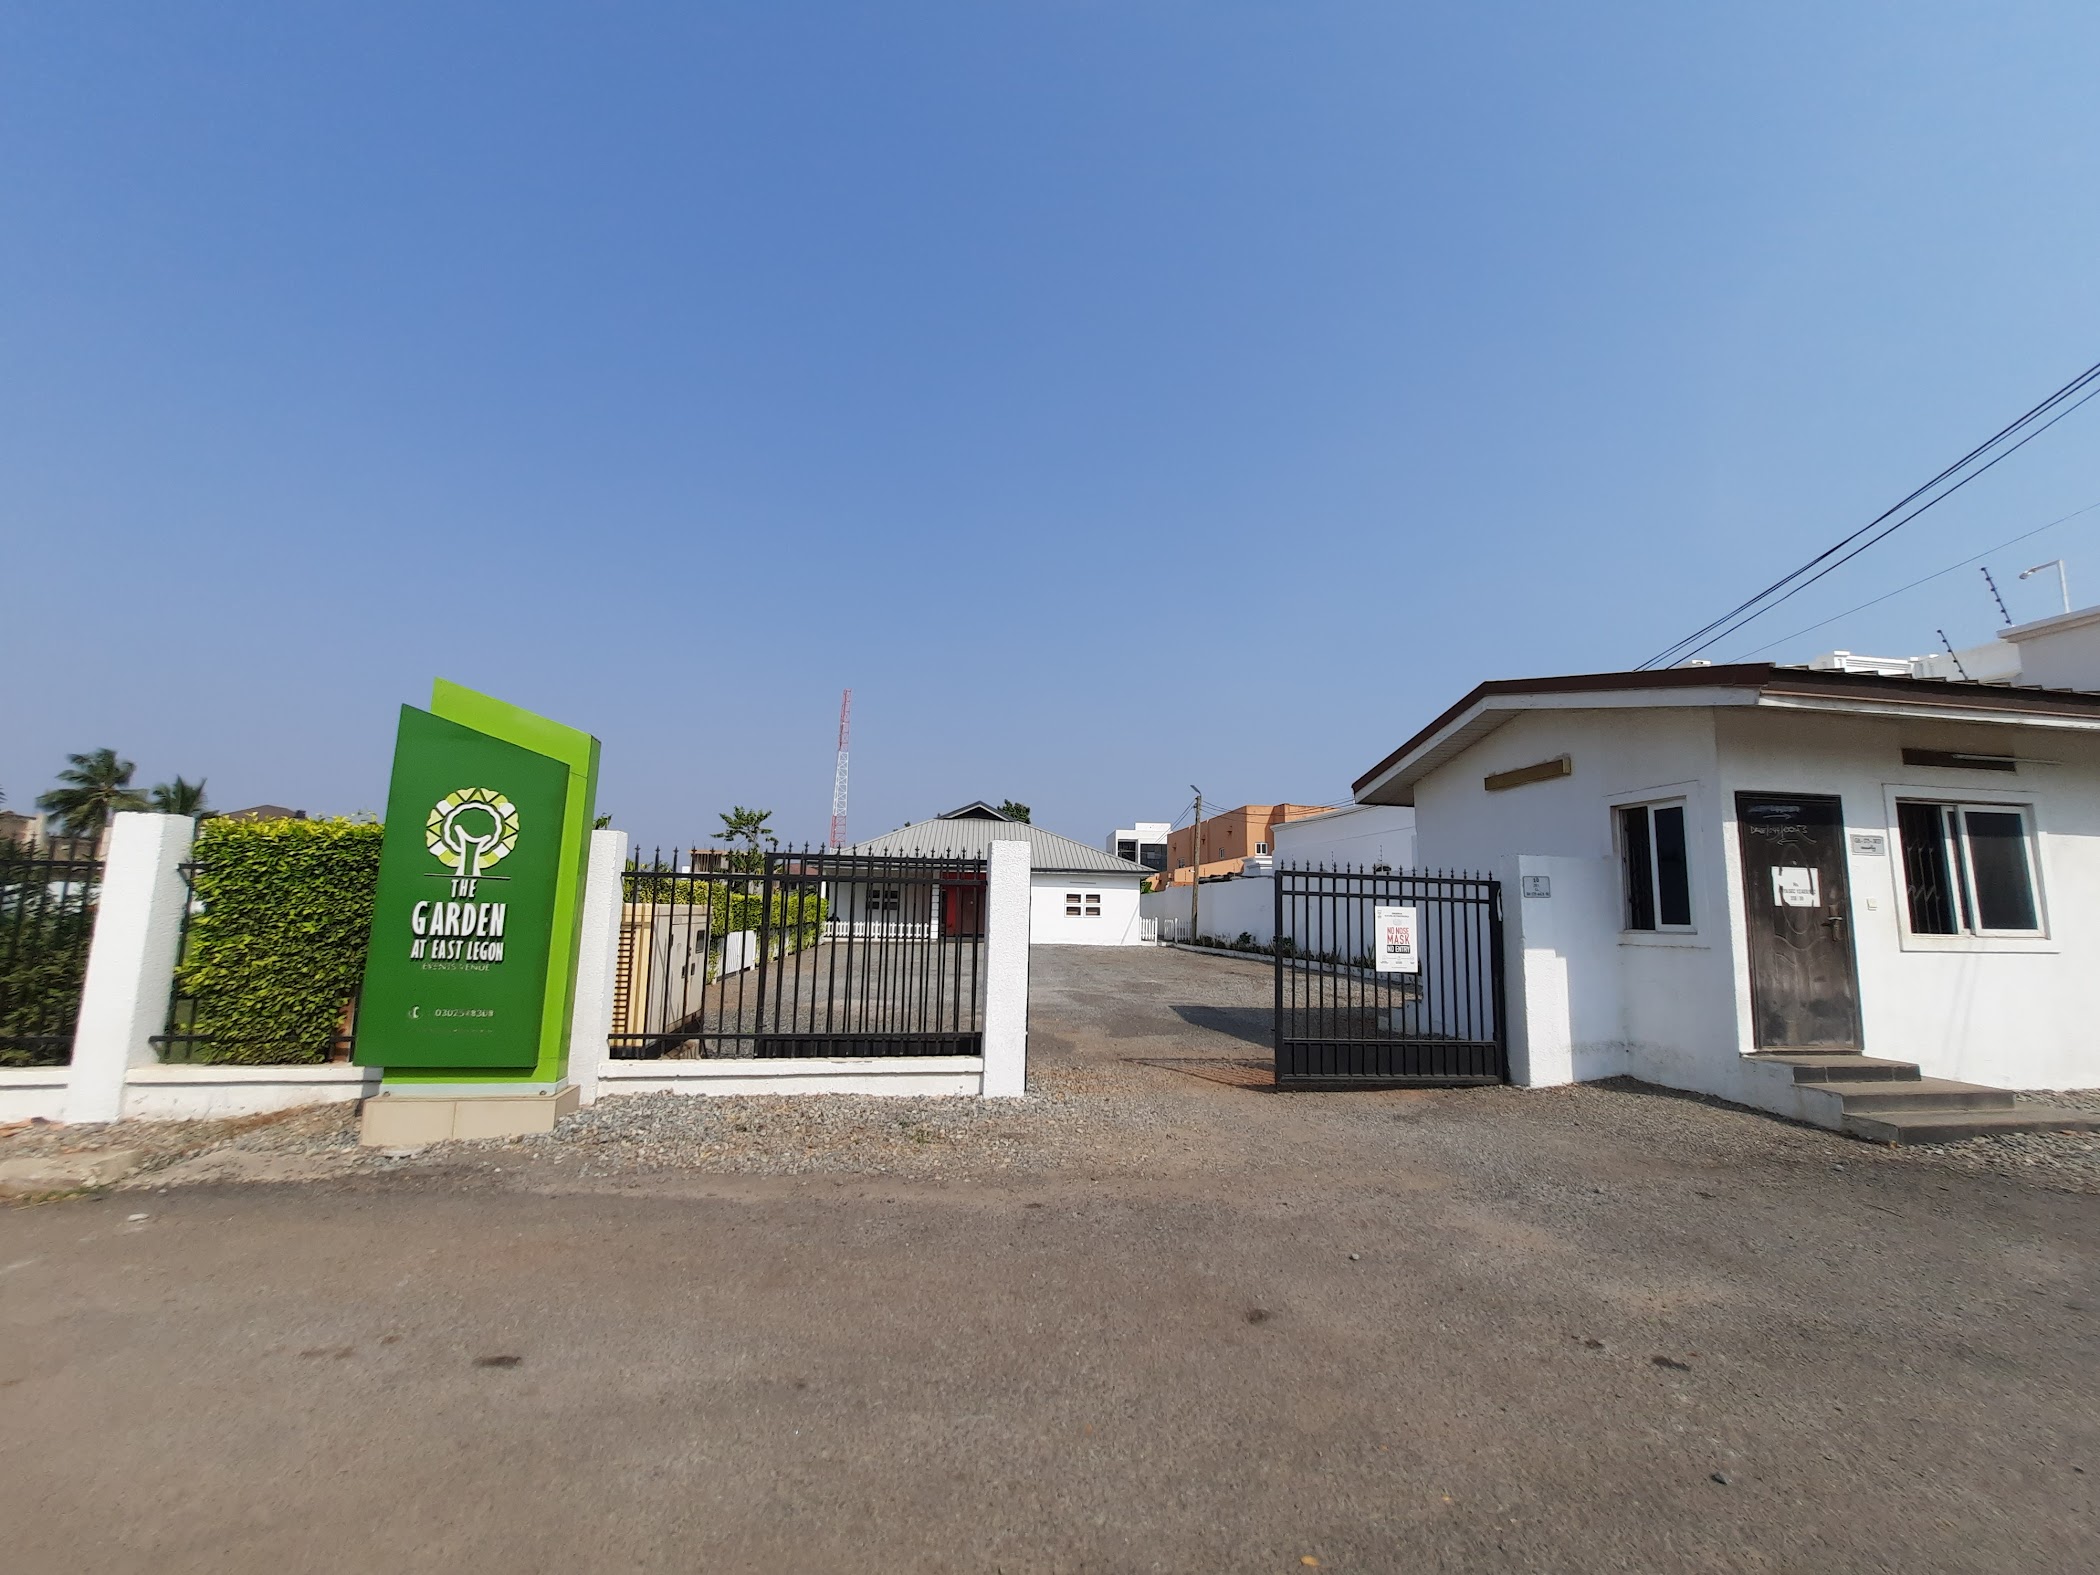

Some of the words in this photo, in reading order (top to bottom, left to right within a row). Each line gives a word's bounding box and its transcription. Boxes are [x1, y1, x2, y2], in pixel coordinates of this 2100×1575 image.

[451, 879, 477, 898] THE
[411, 900, 507, 937] GARDEN
[1396, 927, 1410, 935] NOSE
[1387, 935, 1410, 945] MASK
[410, 939, 428, 959] AT
[431, 940, 463, 960] EAST
[466, 941, 504, 962] LEGON
[1387, 945, 1394, 953] NO
[1395, 945, 1410, 953] ENTRY
